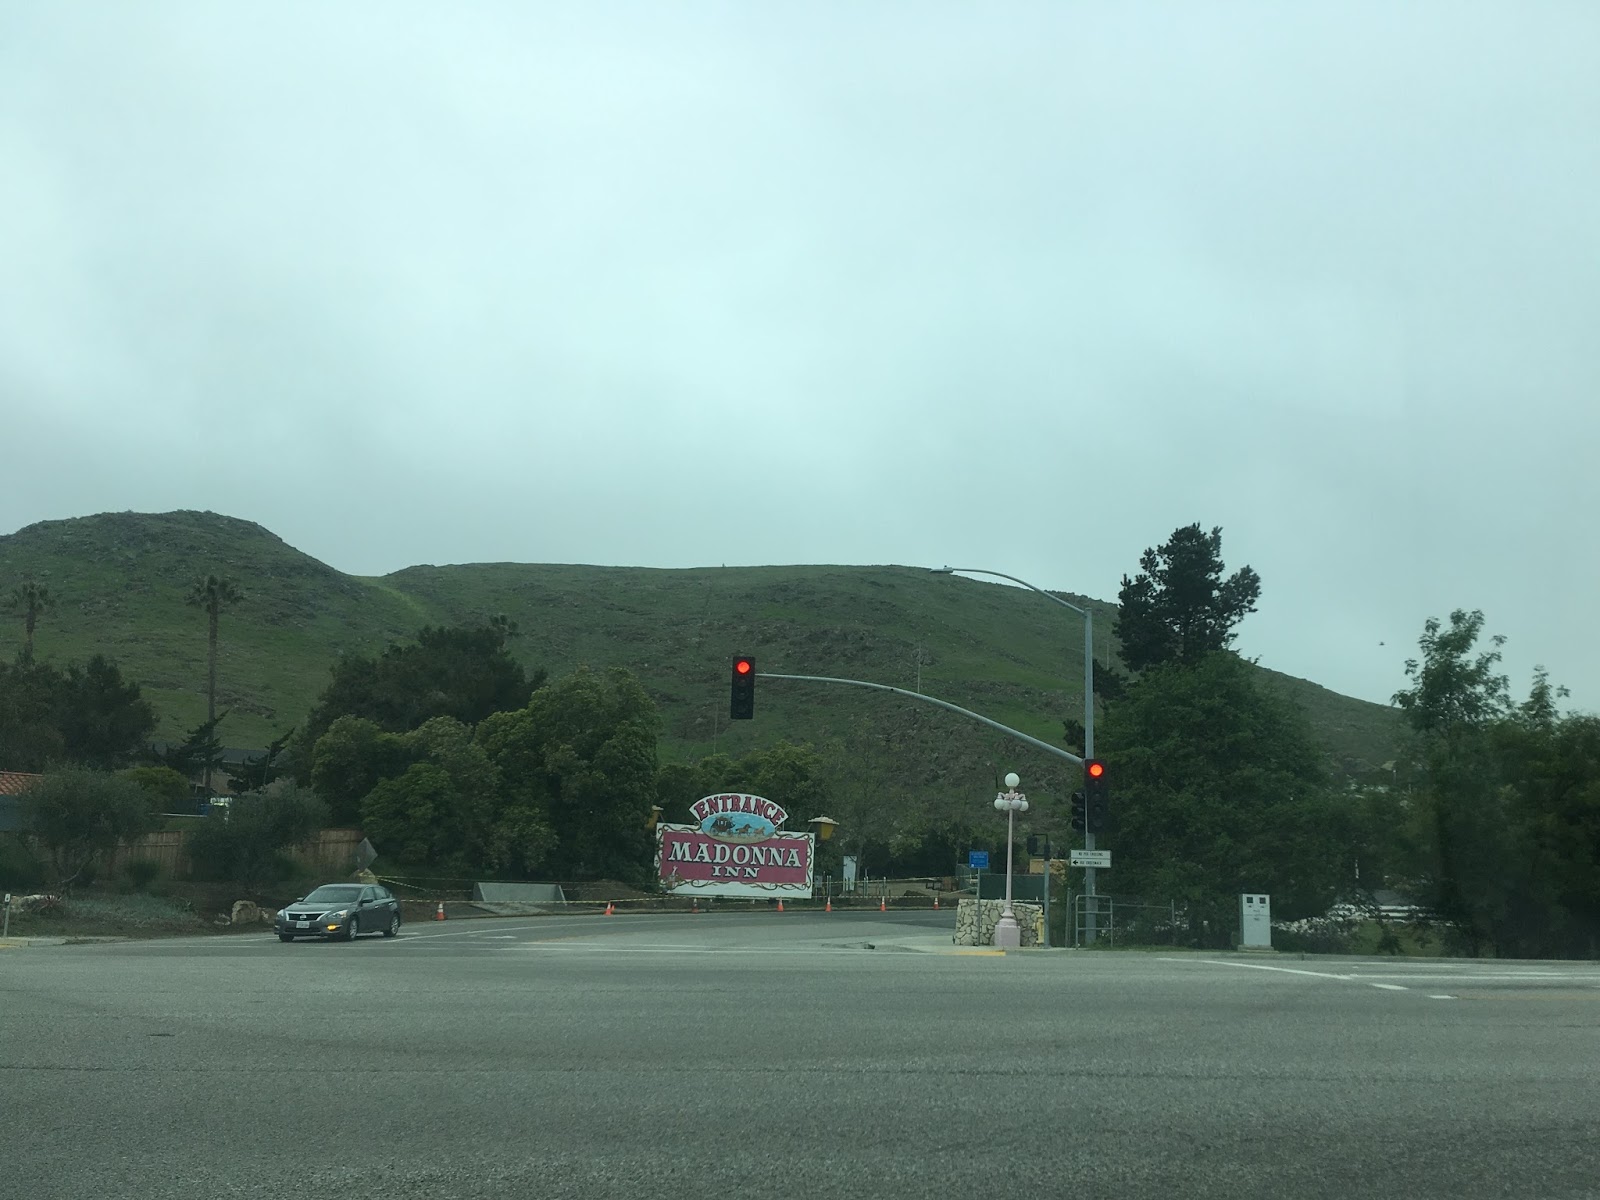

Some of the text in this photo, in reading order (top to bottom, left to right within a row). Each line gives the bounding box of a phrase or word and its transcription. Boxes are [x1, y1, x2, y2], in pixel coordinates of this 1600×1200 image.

[694, 795, 785, 826] ENTRANCE
[668, 841, 802, 867] MADONNA
[712, 866, 760, 878] INN
